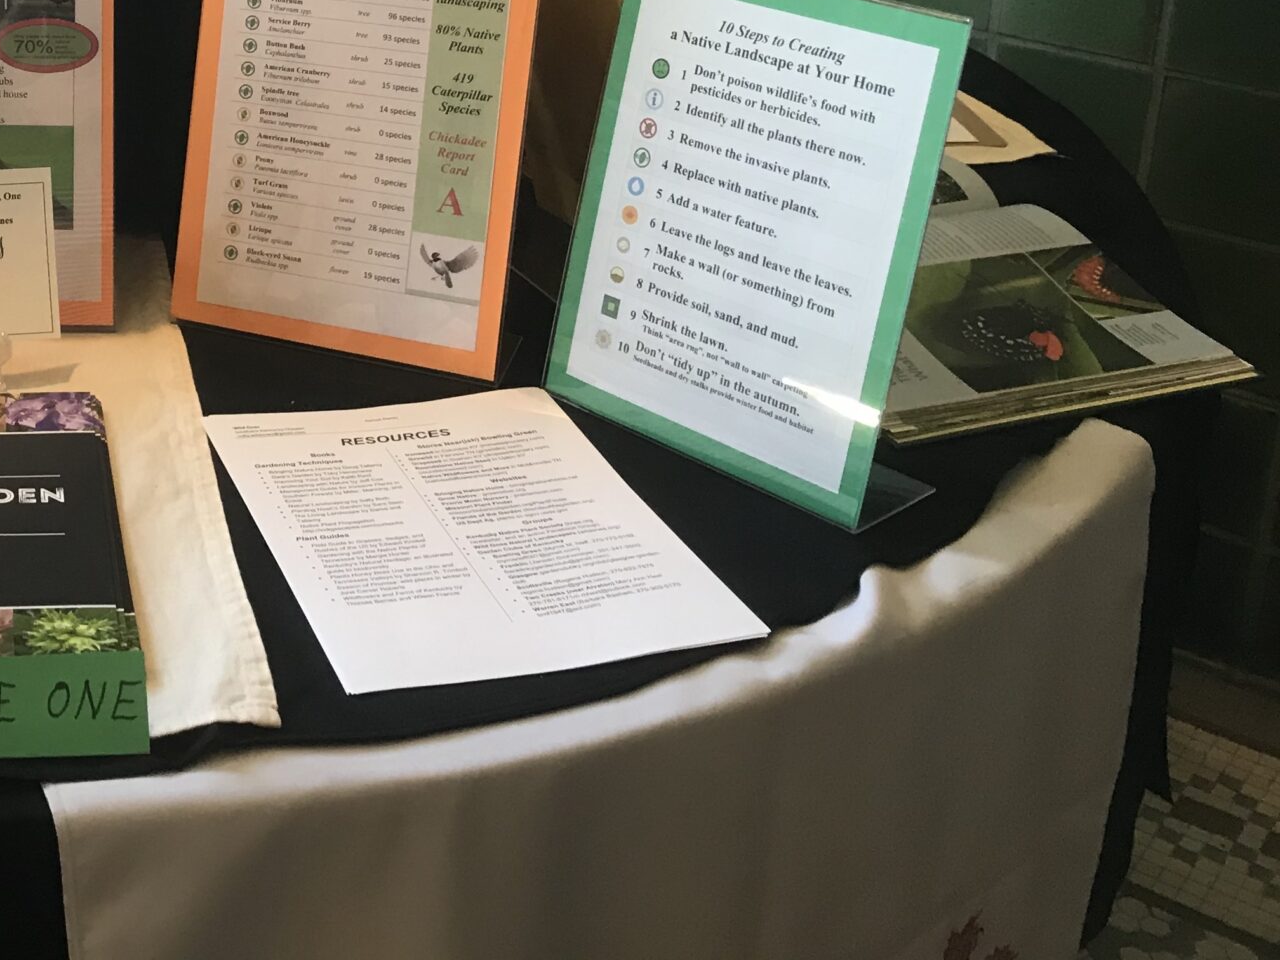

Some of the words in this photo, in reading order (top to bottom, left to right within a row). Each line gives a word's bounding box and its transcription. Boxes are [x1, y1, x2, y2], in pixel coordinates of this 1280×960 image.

[435, 23, 460, 36] 80%
[463, 26, 500, 41] Native
[14, 38, 55, 54] 70%
[448, 40, 483, 54] Plants
[718, 20, 734, 34] 10
[735, 24, 769, 44] Steps
[771, 35, 784, 46] to
[788, 38, 845, 65] Creating
[670, 31, 677, 40] a
[681, 30, 721, 51] Native
[724, 41, 793, 71] Landscape
[796, 63, 810, 74] at
[815, 64, 849, 84] Your
[853, 74, 895, 96] Home
[452, 72, 474, 84] 419
[681, 69, 686, 80] 1
[2, 88, 28, 98] house
[431, 85, 493, 101] Caterpillar
[693, 64, 724, 82] Don’t
[726, 76, 762, 92] poison
[766, 86, 816, 107] wildlife’s
[820, 98, 846, 115] food
[850, 109, 875, 123] with
[438, 101, 480, 115] Species
[689, 83, 741, 104] pesticides
[744, 98, 757, 108] or
[759, 99, 820, 126] herbicides.
[428, 130, 487, 148] Chickadee
[673, 99, 680, 111] 2
[685, 103, 726, 127] Identify
[730, 118, 745, 130] all
[746, 122, 764, 135] the
[766, 128, 801, 146] plants
[804, 139, 835, 156] there
[838, 150, 865, 165] now.
[436, 146, 475, 161] Report
[666, 129, 674, 140] 3
[679, 132, 722, 155] Remove
[724, 147, 742, 161] the
[744, 152, 789, 176] invasive
[791, 169, 830, 189] plants.
[440, 163, 469, 176] Card
[2, 191, 21, 200] One
[436, 187, 463, 216] A
[341, 428, 451, 446] RESOURCES
[46, 679, 142, 721] ONE
